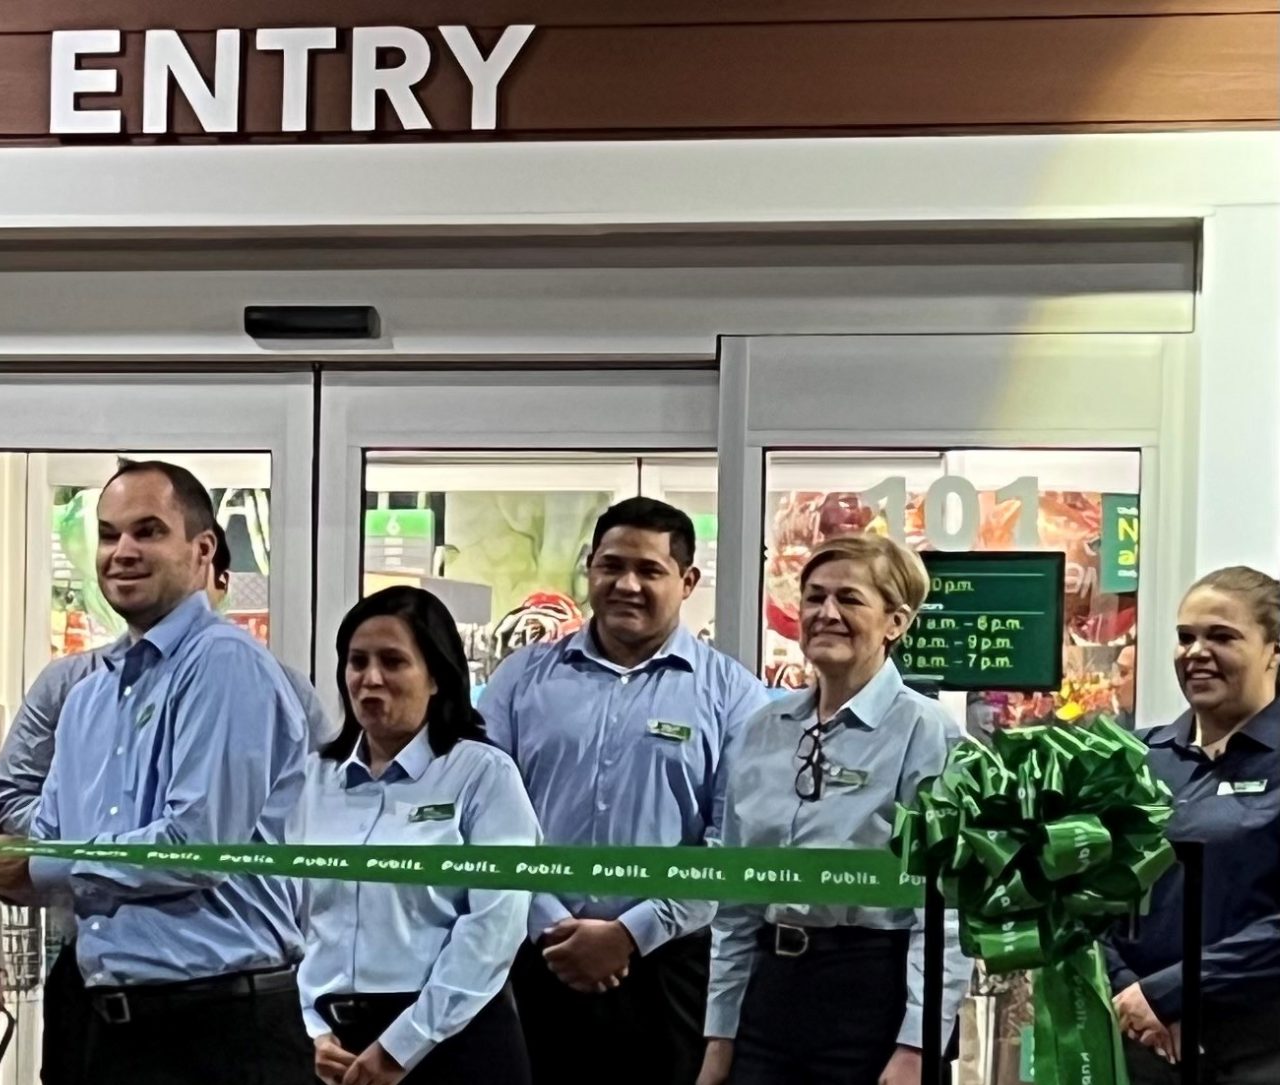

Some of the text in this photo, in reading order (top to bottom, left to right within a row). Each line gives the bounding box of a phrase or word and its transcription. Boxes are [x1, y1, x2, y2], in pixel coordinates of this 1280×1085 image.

[50, 24, 536, 133] ENTRY
[864, 475, 1039, 551] 101
[903, 653, 912, 667] 9
[967, 653, 977, 667] 7
[293, 856, 349, 867] Publix
[366, 858, 424, 870] Publix
[441, 860, 500, 873] Publix
[516, 862, 573, 875] Publix
[592, 863, 650, 878] Publix
[667, 865, 726, 881] Publix
[744, 867, 802, 882] Publix
[820, 870, 880, 885] Publix
